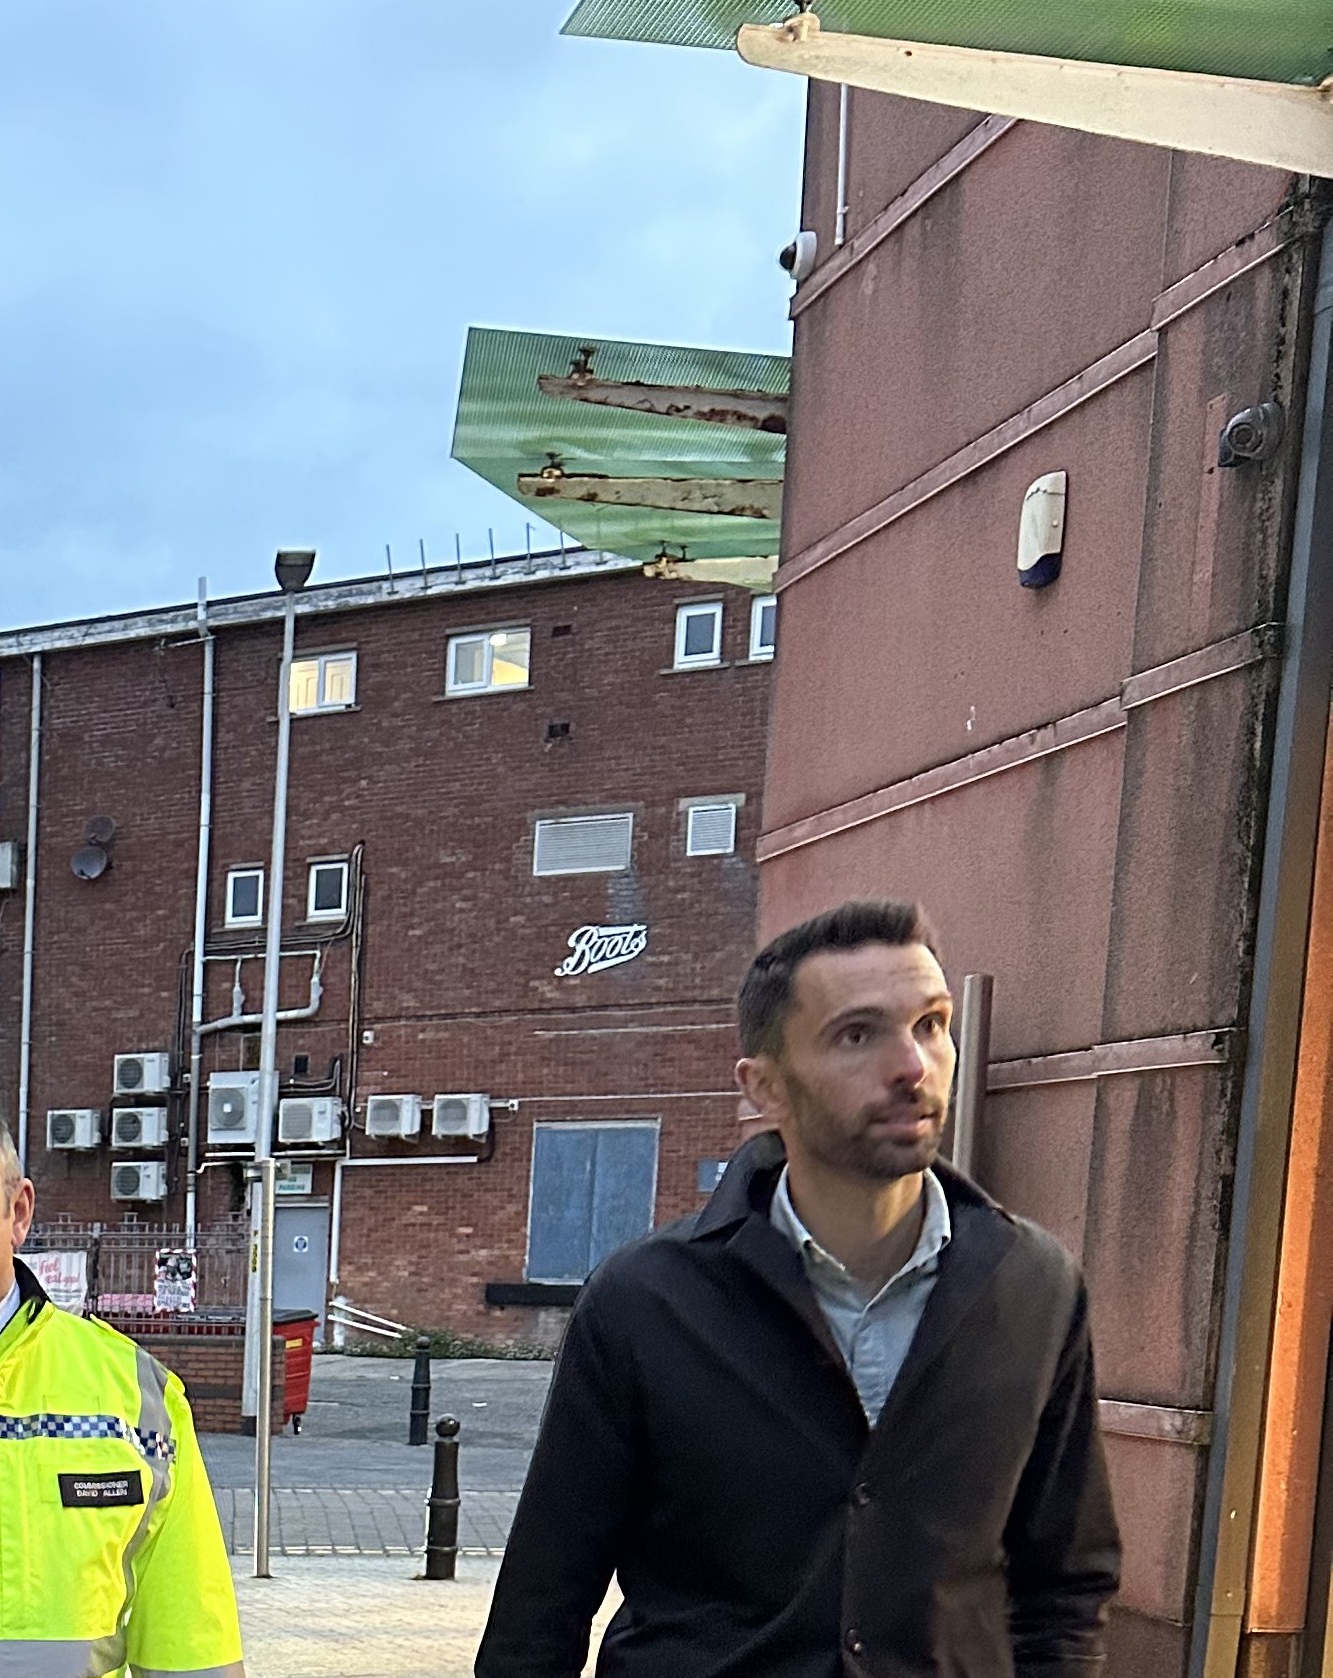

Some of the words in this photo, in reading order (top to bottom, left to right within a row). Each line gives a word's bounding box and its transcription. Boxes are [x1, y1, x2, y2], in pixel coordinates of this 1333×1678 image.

[554, 924, 647, 976] Boots
[73, 1480, 129, 1490] COMMISSIONER
[76, 1489, 99, 1498] DAVID
[103, 1488, 128, 1497] ALLEN
